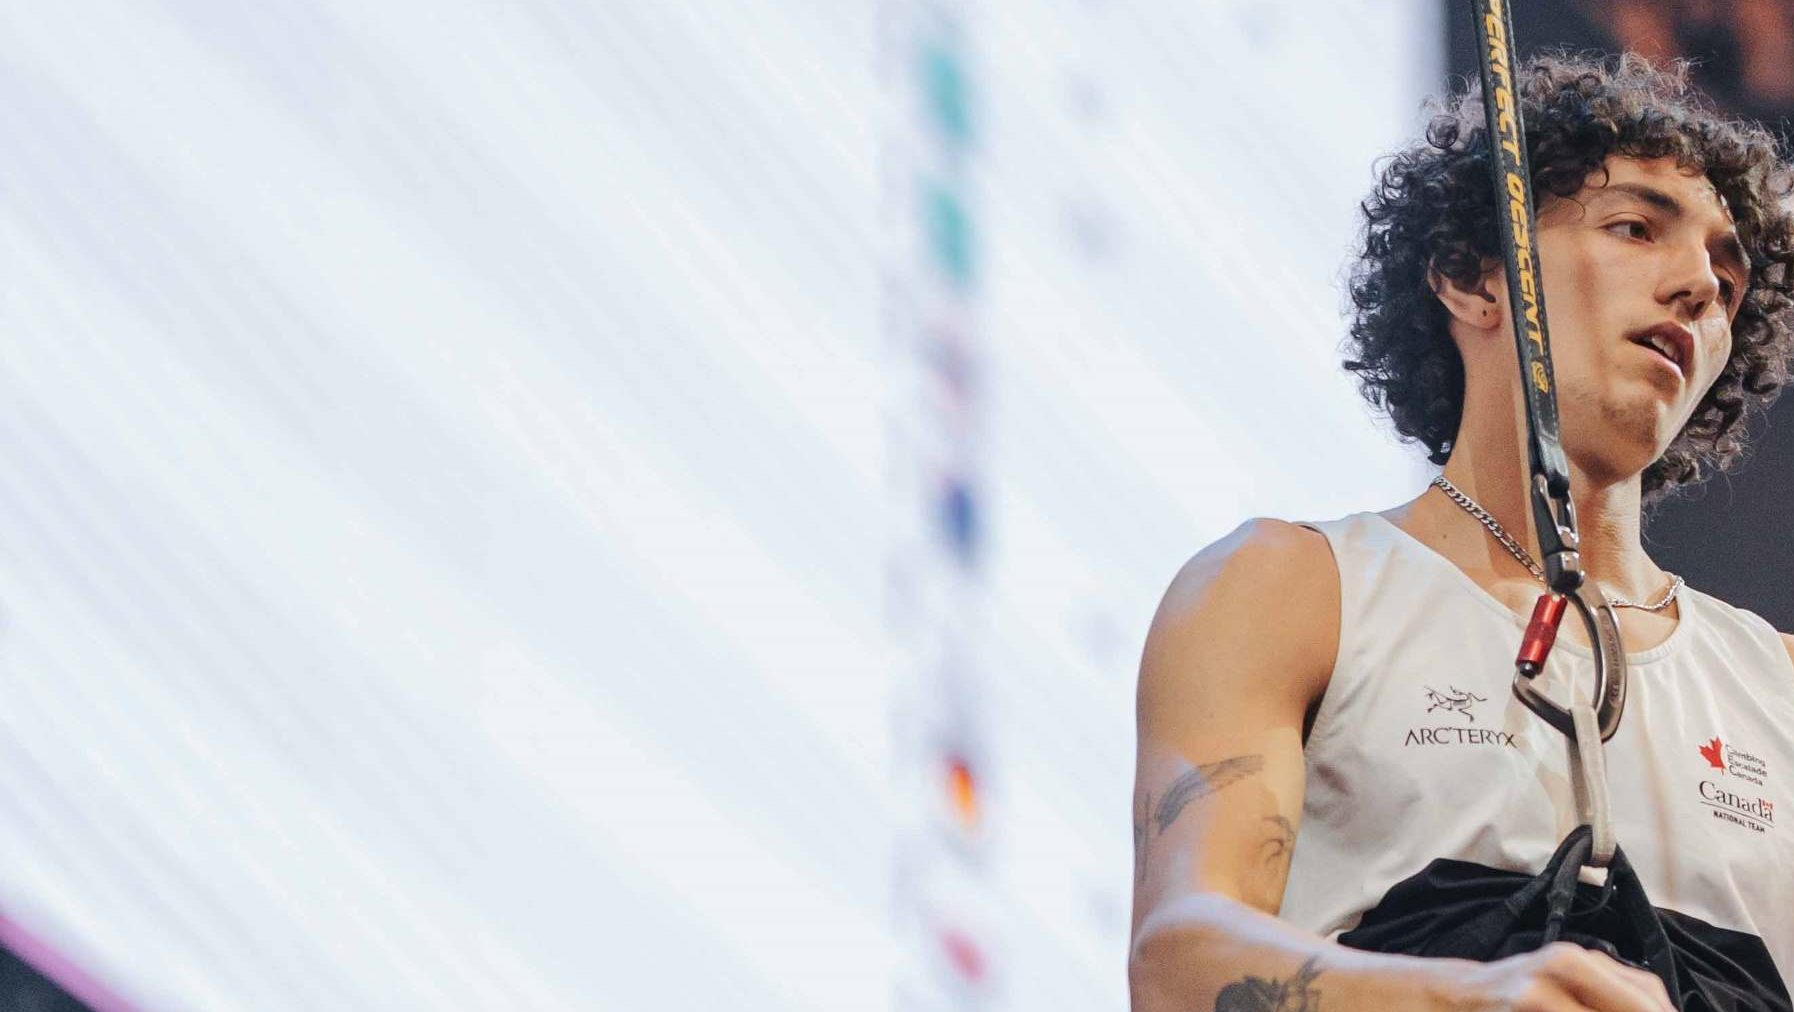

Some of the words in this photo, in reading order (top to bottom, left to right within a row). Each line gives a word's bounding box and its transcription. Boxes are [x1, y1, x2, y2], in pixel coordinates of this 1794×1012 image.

[1506, 172, 1544, 355] DESCENT
[1699, 780, 1774, 821] Canada
[1713, 810, 1747, 828] NATIONAL
[1747, 820, 1765, 833] TEAM
